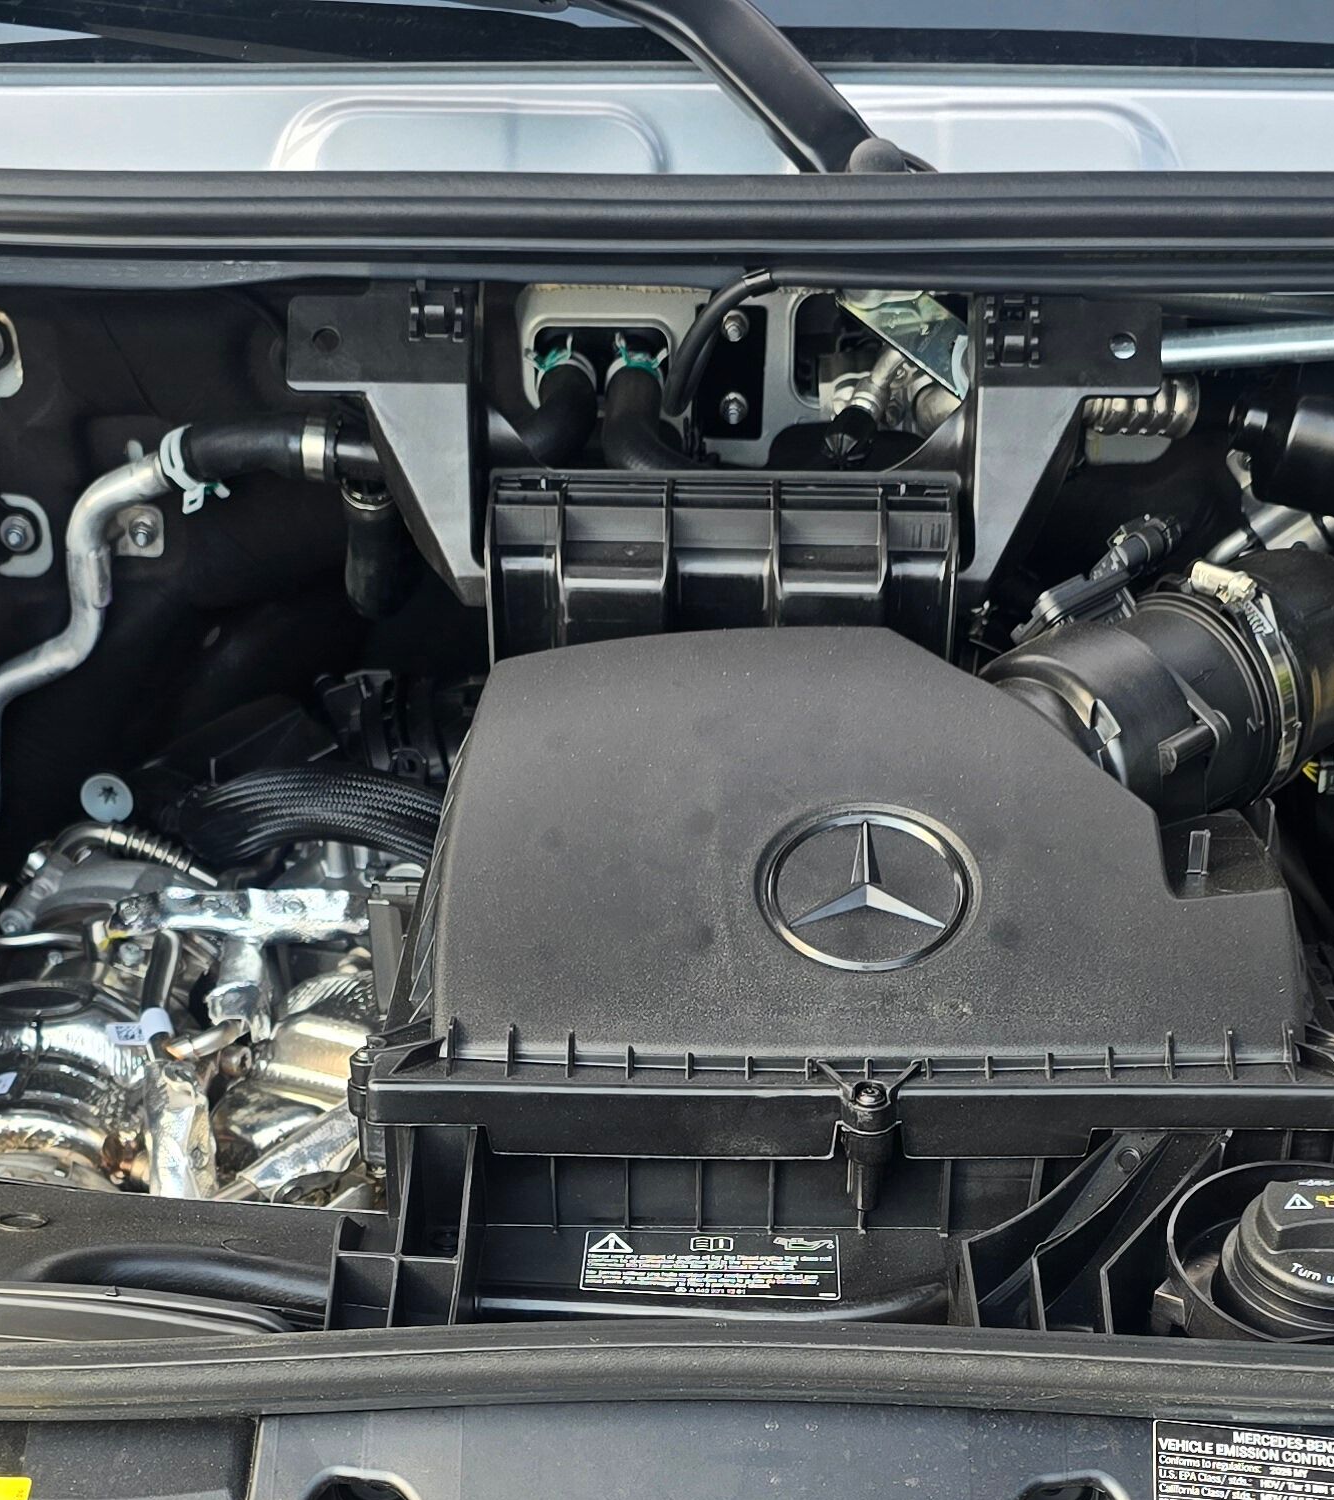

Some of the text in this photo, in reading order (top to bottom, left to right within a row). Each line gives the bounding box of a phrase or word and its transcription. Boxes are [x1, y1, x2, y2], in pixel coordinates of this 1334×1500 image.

[1291, 1262, 1322, 1281] Turn
[1158, 1437, 1214, 1454] VEHICLE
[1215, 1443, 1279, 1461] EMISSION
[1158, 1454, 1200, 1468] Conforms
[1202, 1459, 1211, 1468] to
[1158, 1482, 1200, 1495] California
